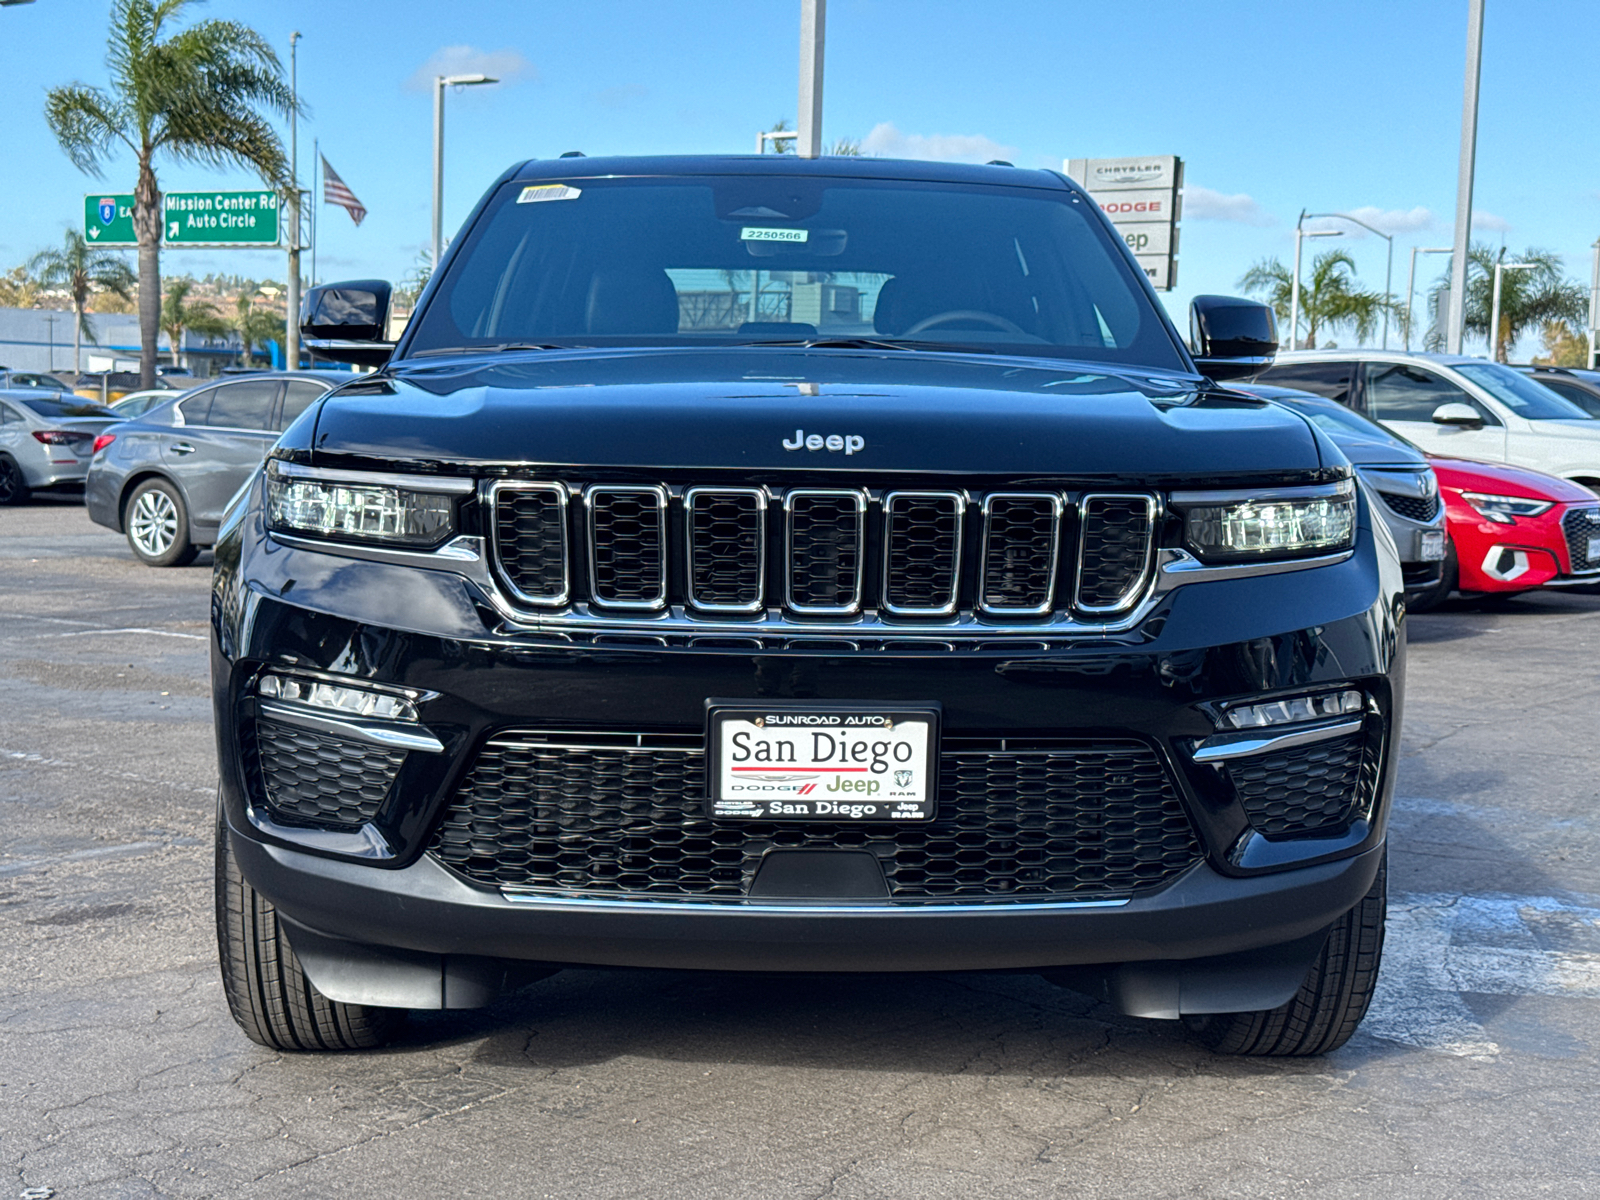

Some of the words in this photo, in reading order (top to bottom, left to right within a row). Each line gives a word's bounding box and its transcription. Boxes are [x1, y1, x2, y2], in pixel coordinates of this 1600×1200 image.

[1096, 165, 1161, 174] CHRYSLER
[166, 196, 213, 211] Mission
[215, 195, 257, 210] Center
[260, 194, 277, 210] Rd
[104, 205, 111, 219] 8
[119, 206, 133, 218] EA
[187, 213, 217, 228] Auto
[220, 212, 256, 228] Circle
[747, 230, 801, 240] 2250566
[1124, 233, 1148, 251] ep
[782, 429, 865, 455] Jeep
[765, 715, 841, 725] SUNROAD
[844, 716, 885, 725] AUTO
[732, 731, 798, 762] San
[811, 730, 912, 774] Diego
[826, 775, 880, 796] Jeep
[769, 801, 809, 814] San
[815, 801, 877, 818] Diego
[897, 802, 919, 811] Jeep
